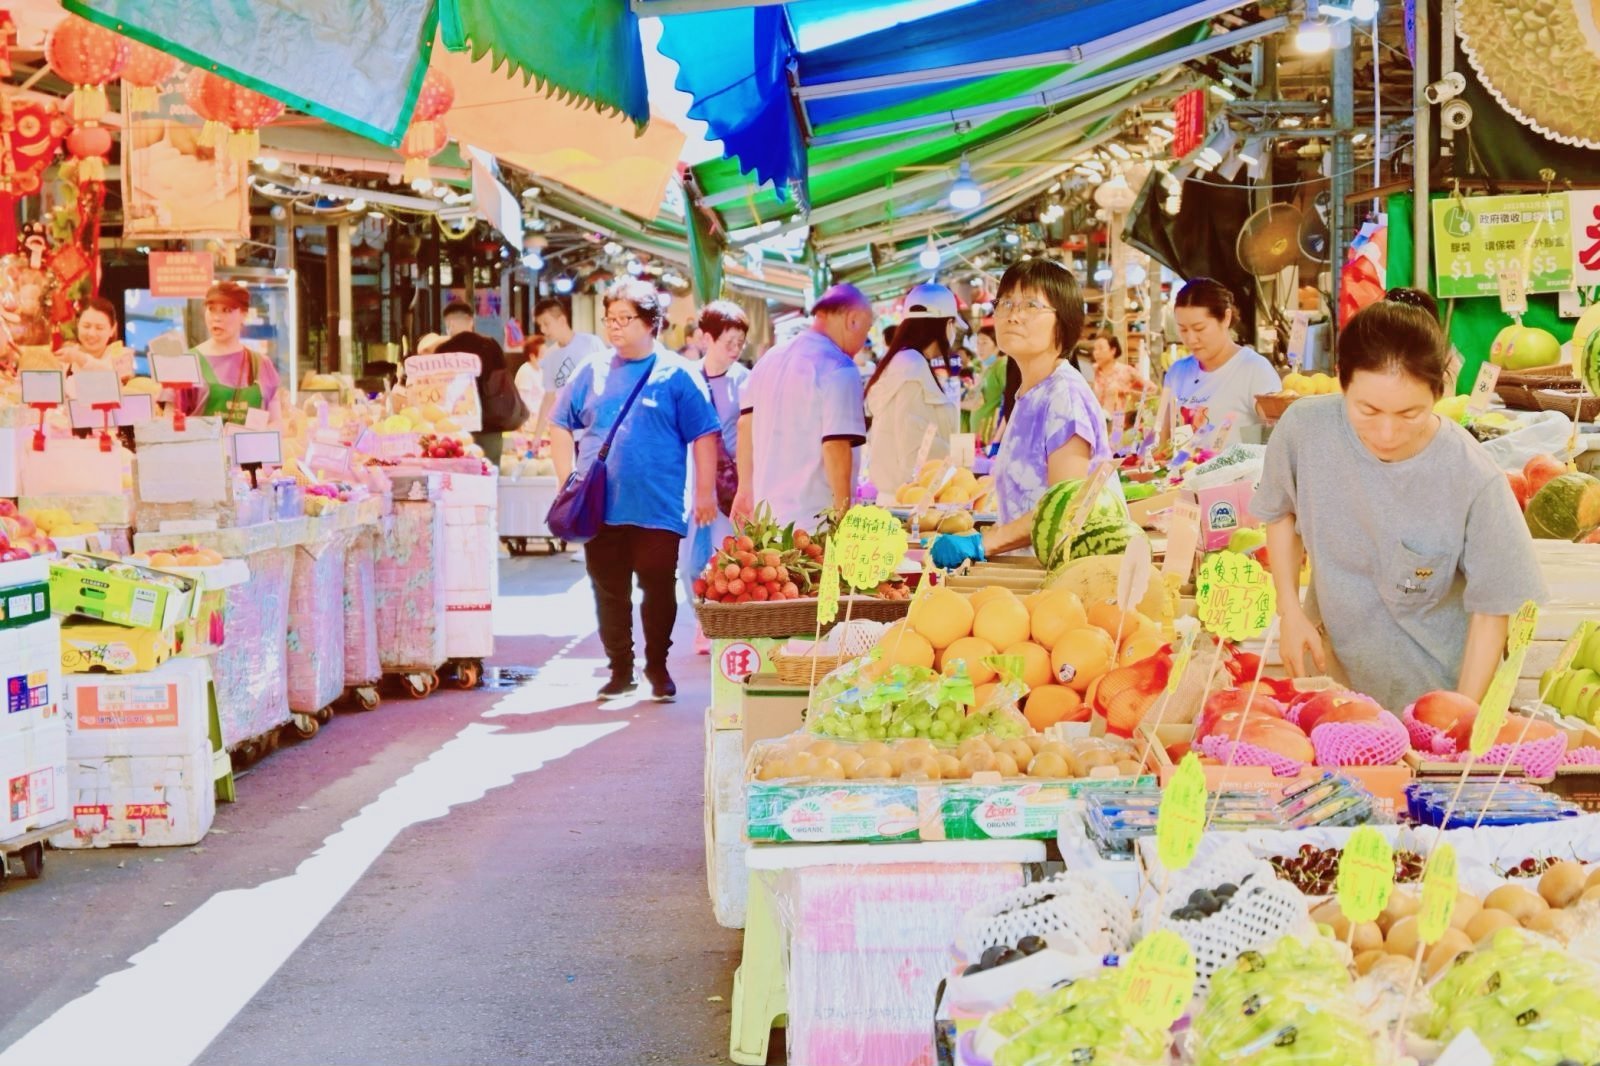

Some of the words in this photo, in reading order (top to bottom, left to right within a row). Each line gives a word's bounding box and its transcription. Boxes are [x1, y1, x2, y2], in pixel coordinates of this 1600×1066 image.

[1451, 260, 1475, 281] $1
[1533, 255, 1557, 277] $5
[407, 352, 478, 374] Sunkist
[726, 649, 753, 676] 旺
[986, 821, 1017, 829] ORGANIC
